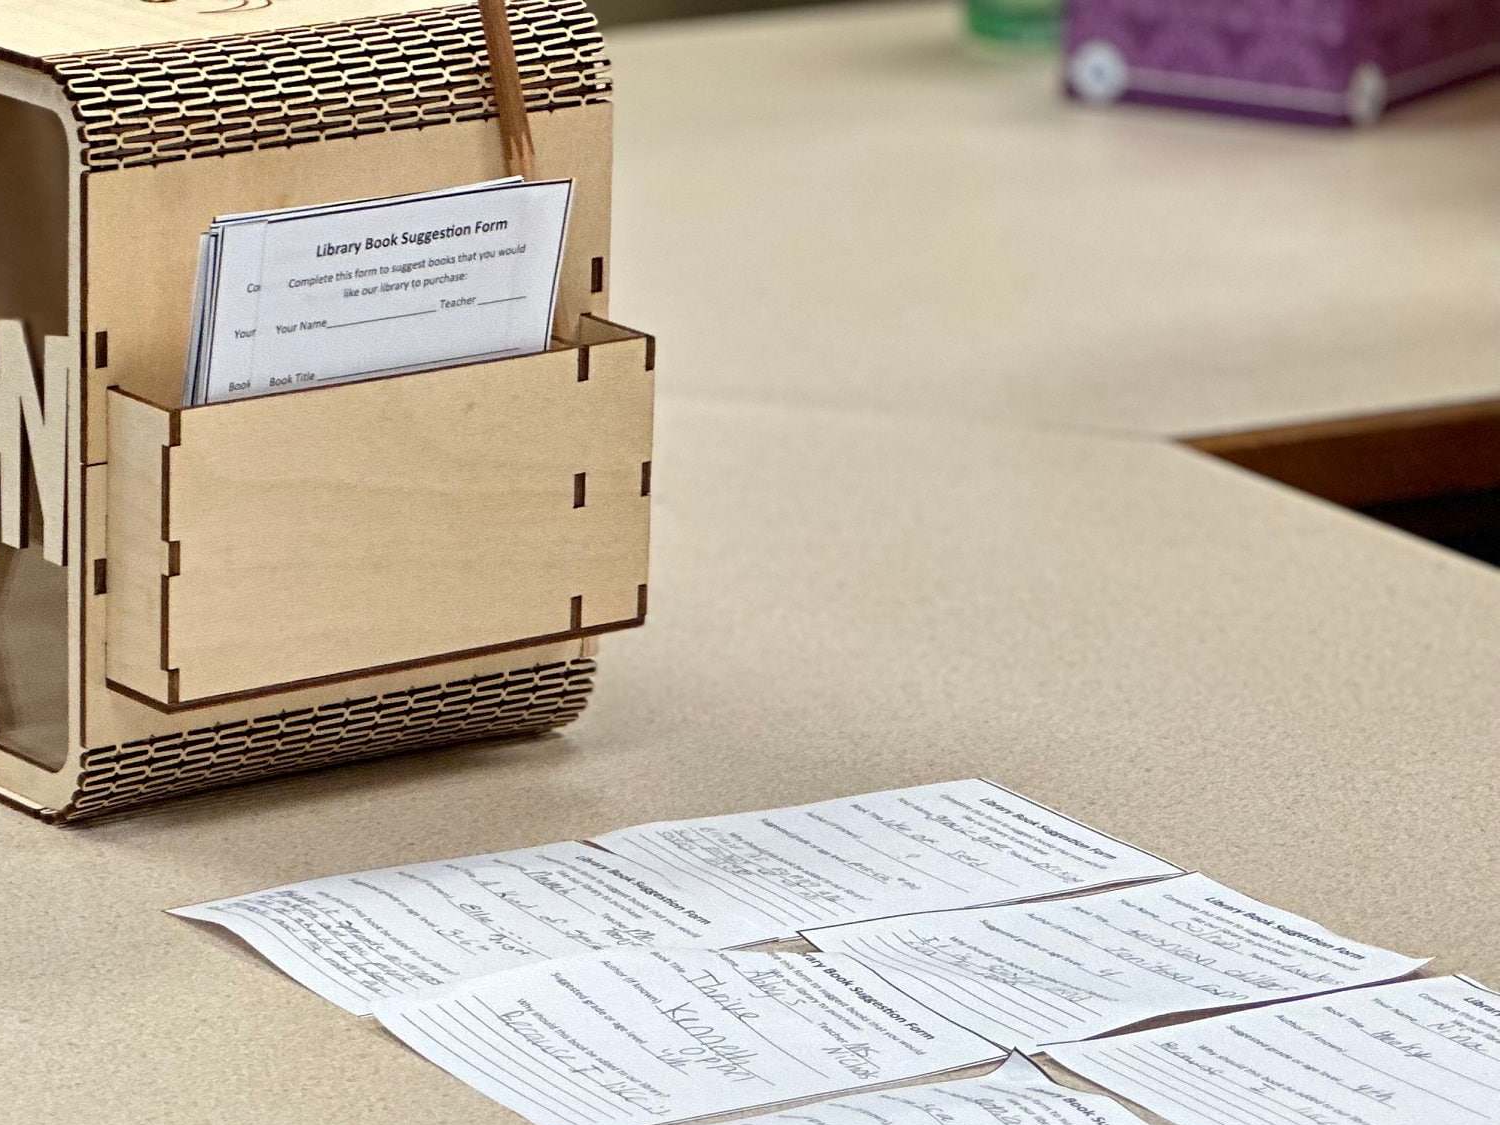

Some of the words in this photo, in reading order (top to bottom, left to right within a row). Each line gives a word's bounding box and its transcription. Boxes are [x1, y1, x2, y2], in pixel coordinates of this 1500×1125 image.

[316, 242, 362, 258] Library
[365, 233, 399, 251] Book
[401, 224, 471, 245] Suggestion
[474, 218, 508, 236] Form
[288, 271, 333, 289] Complete
[335, 269, 352, 282] this
[354, 266, 378, 279] form
[379, 264, 389, 275] to
[391, 259, 426, 276] suggest
[428, 255, 456, 269] books
[458, 251, 477, 263] that
[479, 250, 496, 262] you
[498, 244, 526, 257] would
[343, 287, 359, 298] like
[361, 286, 378, 296] our
[380, 281, 409, 294] library
[411, 279, 421, 288] to
[423, 272, 467, 289] purchase:
[276, 323, 298, 335] Your
[300, 319, 327, 331] Name
[440, 296, 477, 309] Teacher
[234, 328, 256, 340] Your
[269, 374, 293, 387] Book
[295, 371, 315, 383] Title
[633, 881, 684, 910] Suggestion
[684, 910, 710, 924] Form
[552, 973, 588, 999] Suggested
[582, 1000, 606, 1015] grade
[612, 1022, 627, 1031] age
[802, 954, 825, 967] rary
[824, 968, 852, 986] Book
[850, 987, 905, 1022] Suggestion
[905, 1023, 934, 1039] Form
[846, 1007, 870, 1021] books
[868, 1021, 887, 1032] that
[883, 1032, 900, 1040] you
[1392, 1009, 1417, 1021] Name
[818, 1022, 847, 1042] Teacher
[1063, 1098, 1094, 1116] Book
